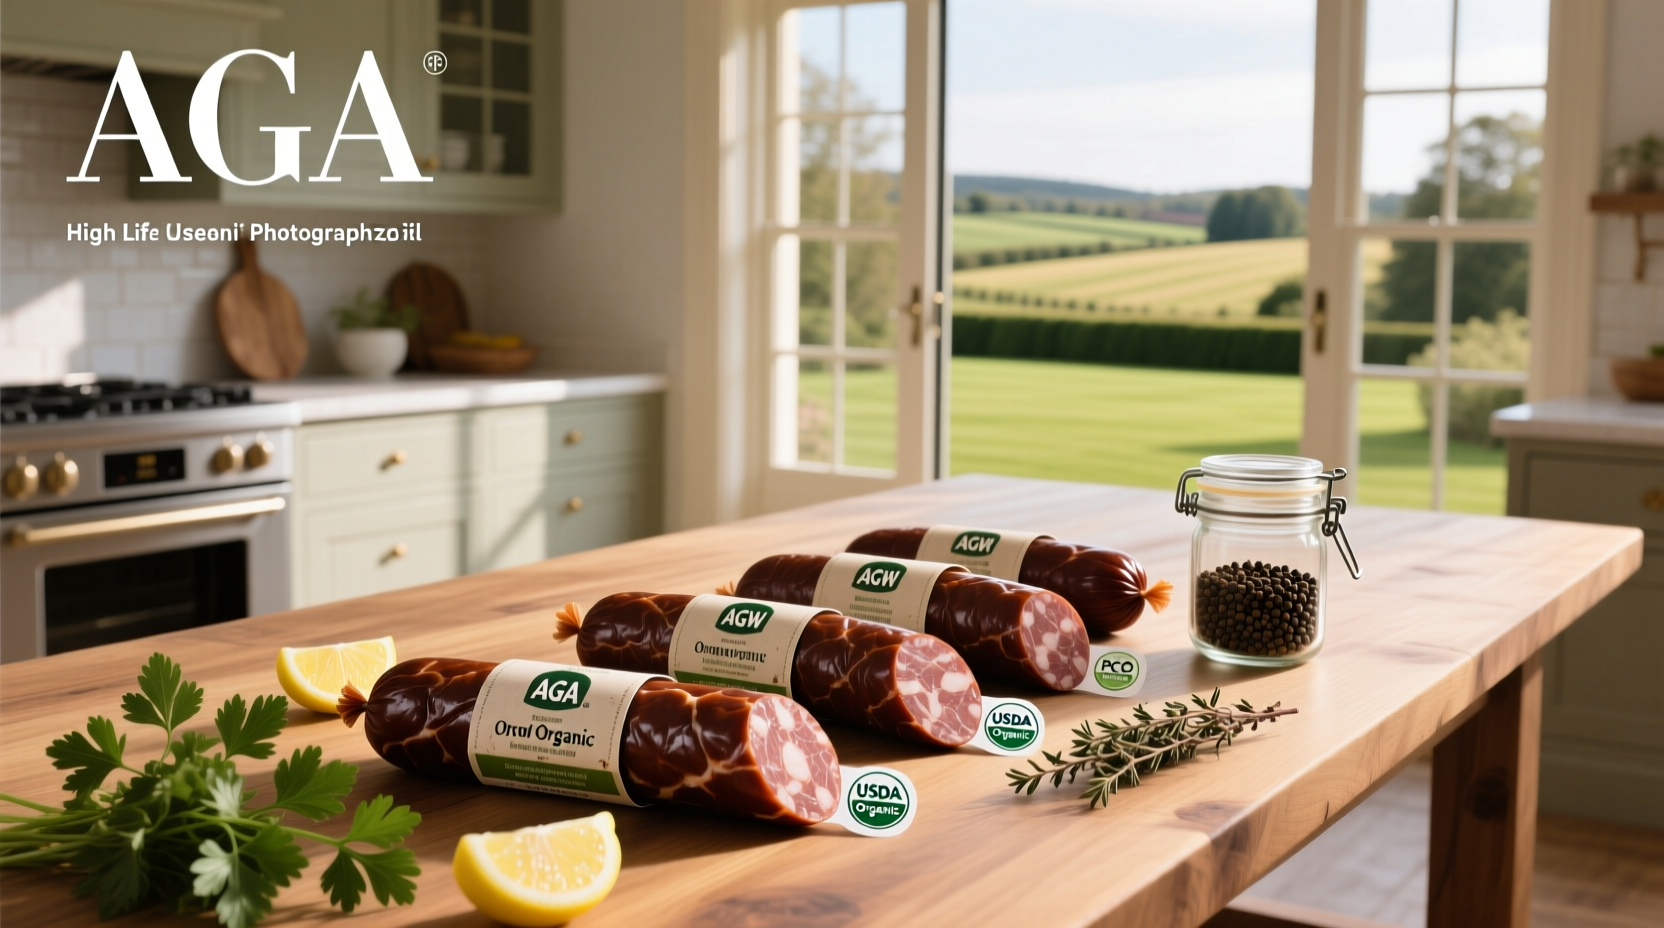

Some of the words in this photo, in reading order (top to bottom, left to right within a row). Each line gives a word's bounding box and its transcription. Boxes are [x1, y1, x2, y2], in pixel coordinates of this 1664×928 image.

[954, 535, 994, 553] AGW
[856, 568, 900, 588] AGW
[720, 608, 768, 629] AGW
[1101, 659, 1134, 673] PCO
[530, 678, 579, 705] AGA
[992, 712, 1032, 727] USDA
[535, 724, 595, 747] Organic
[856, 783, 902, 800] USDA
